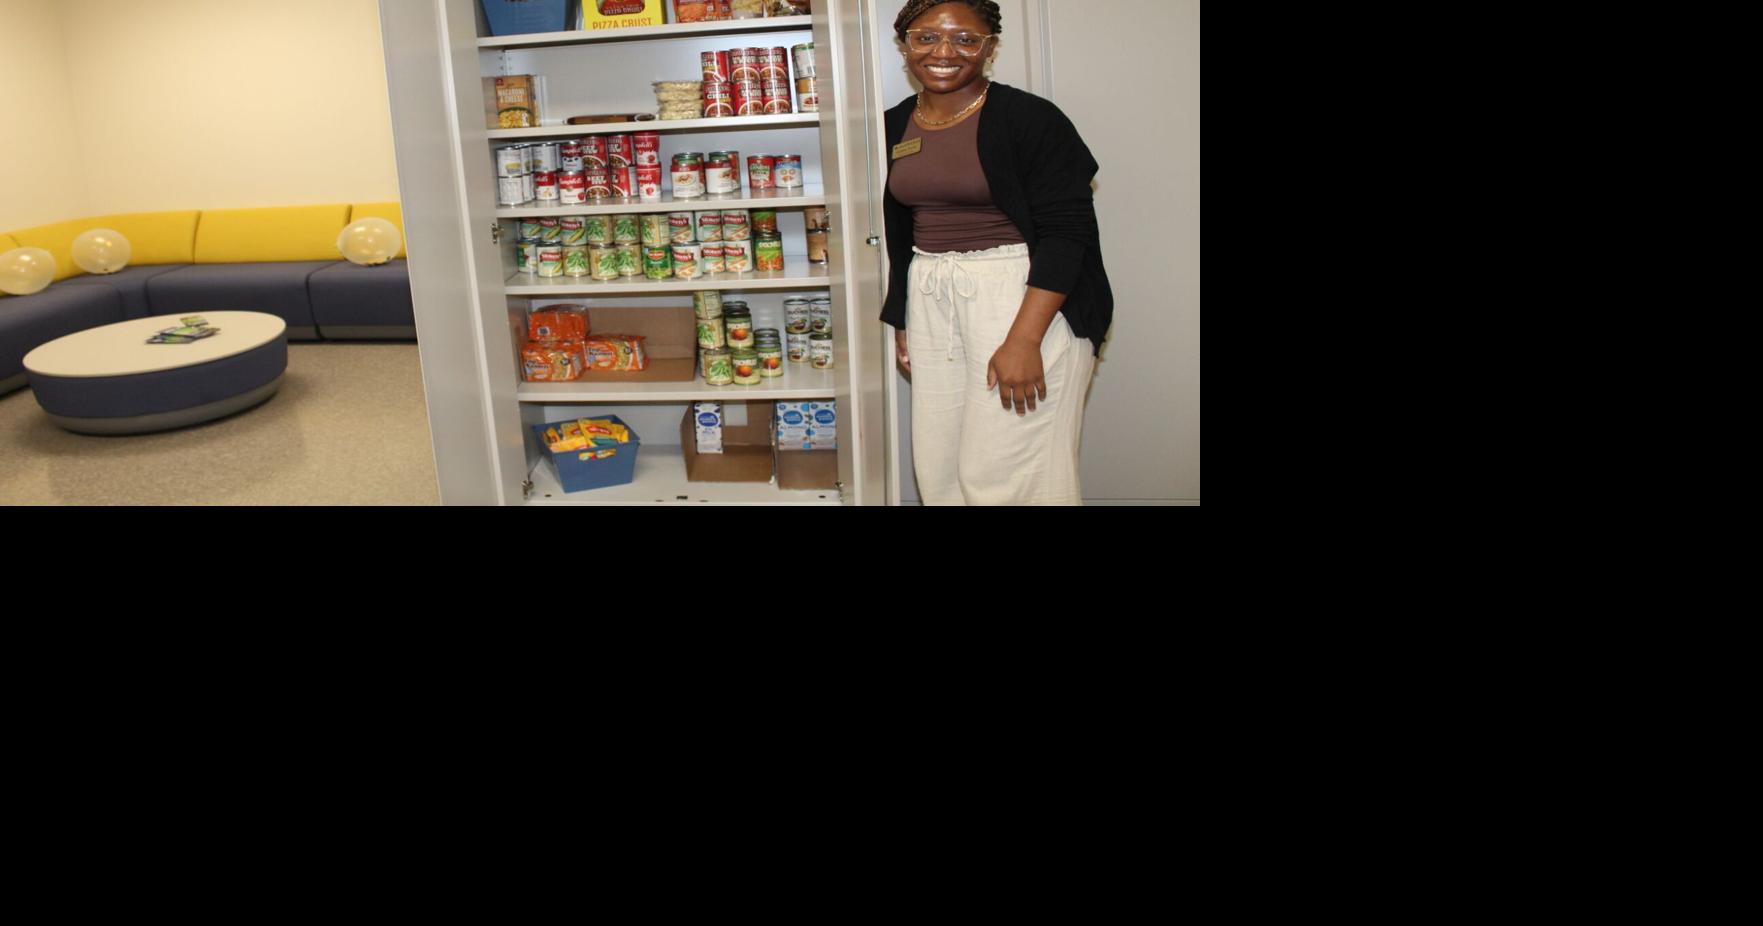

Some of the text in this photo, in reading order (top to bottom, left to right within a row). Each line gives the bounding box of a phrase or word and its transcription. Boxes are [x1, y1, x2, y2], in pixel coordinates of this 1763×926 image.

[592, 17, 652, 30] PIZZA CRUST
[559, 177, 583, 185] Campbell's
